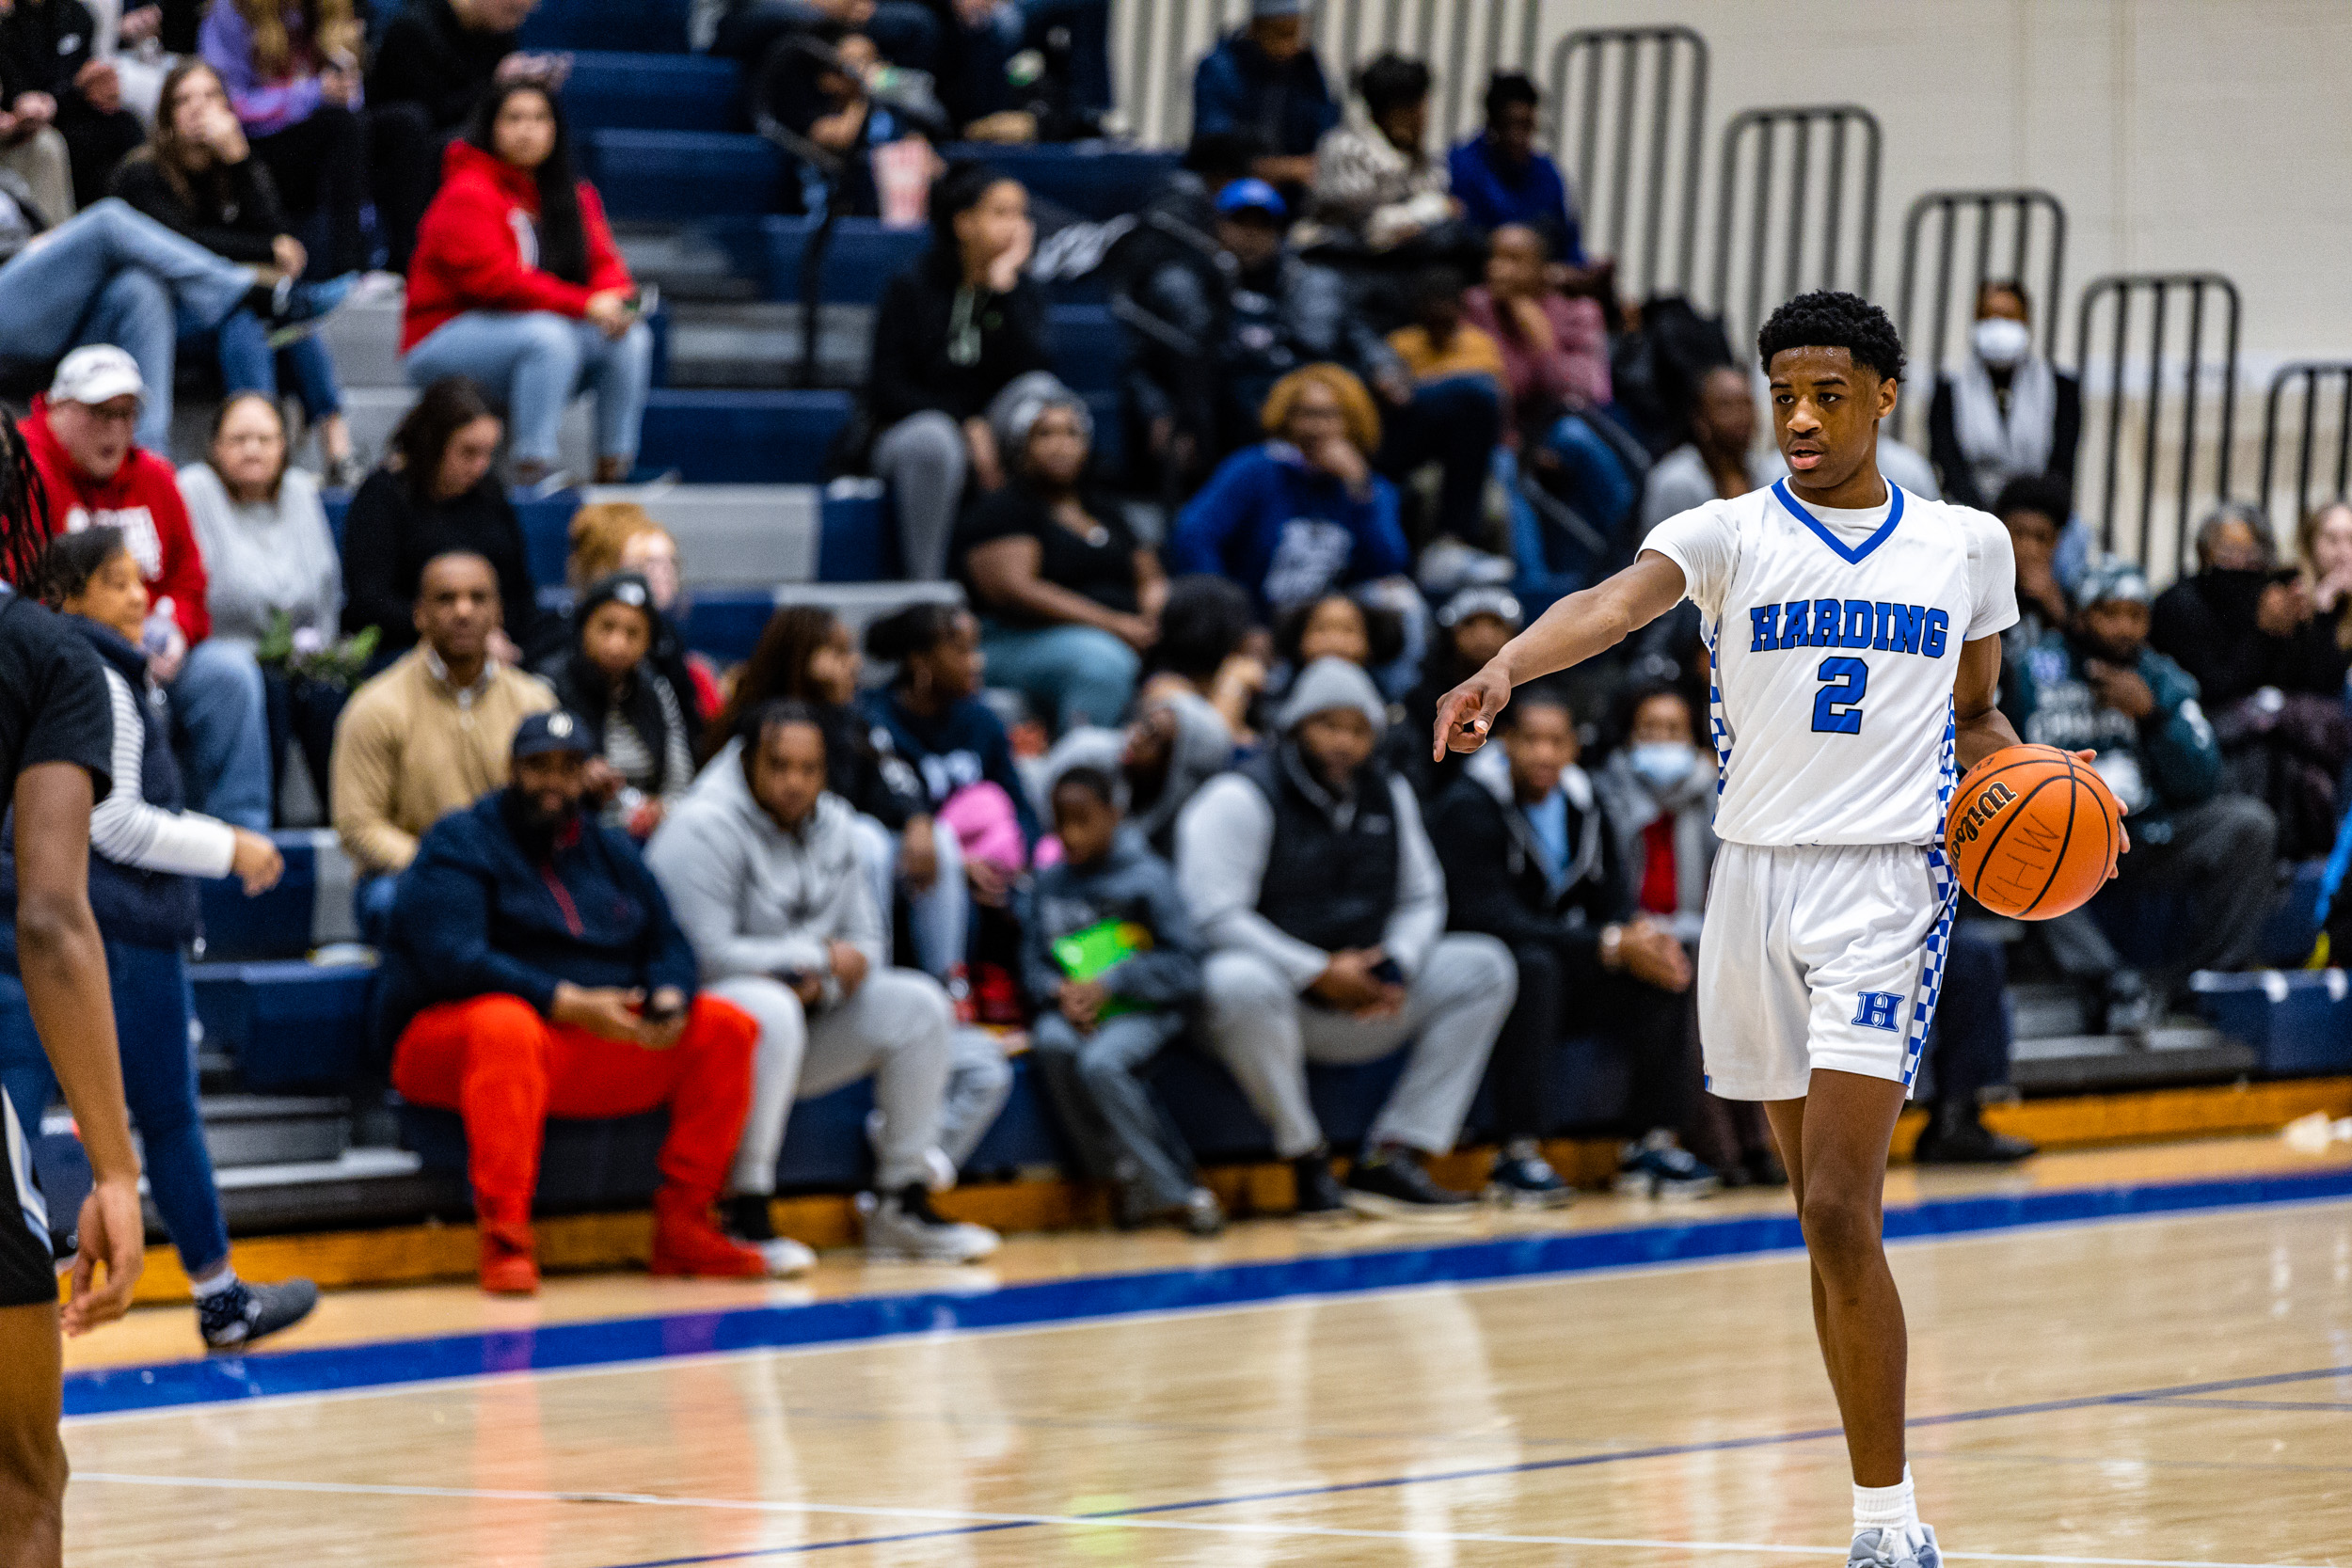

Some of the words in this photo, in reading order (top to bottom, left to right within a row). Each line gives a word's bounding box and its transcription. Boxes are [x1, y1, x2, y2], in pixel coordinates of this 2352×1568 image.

[1750, 598, 1949, 658] HARDING
[1811, 656, 1869, 735] 2
[1982, 812, 2060, 908] MHA
[1851, 990, 1905, 1033] H
